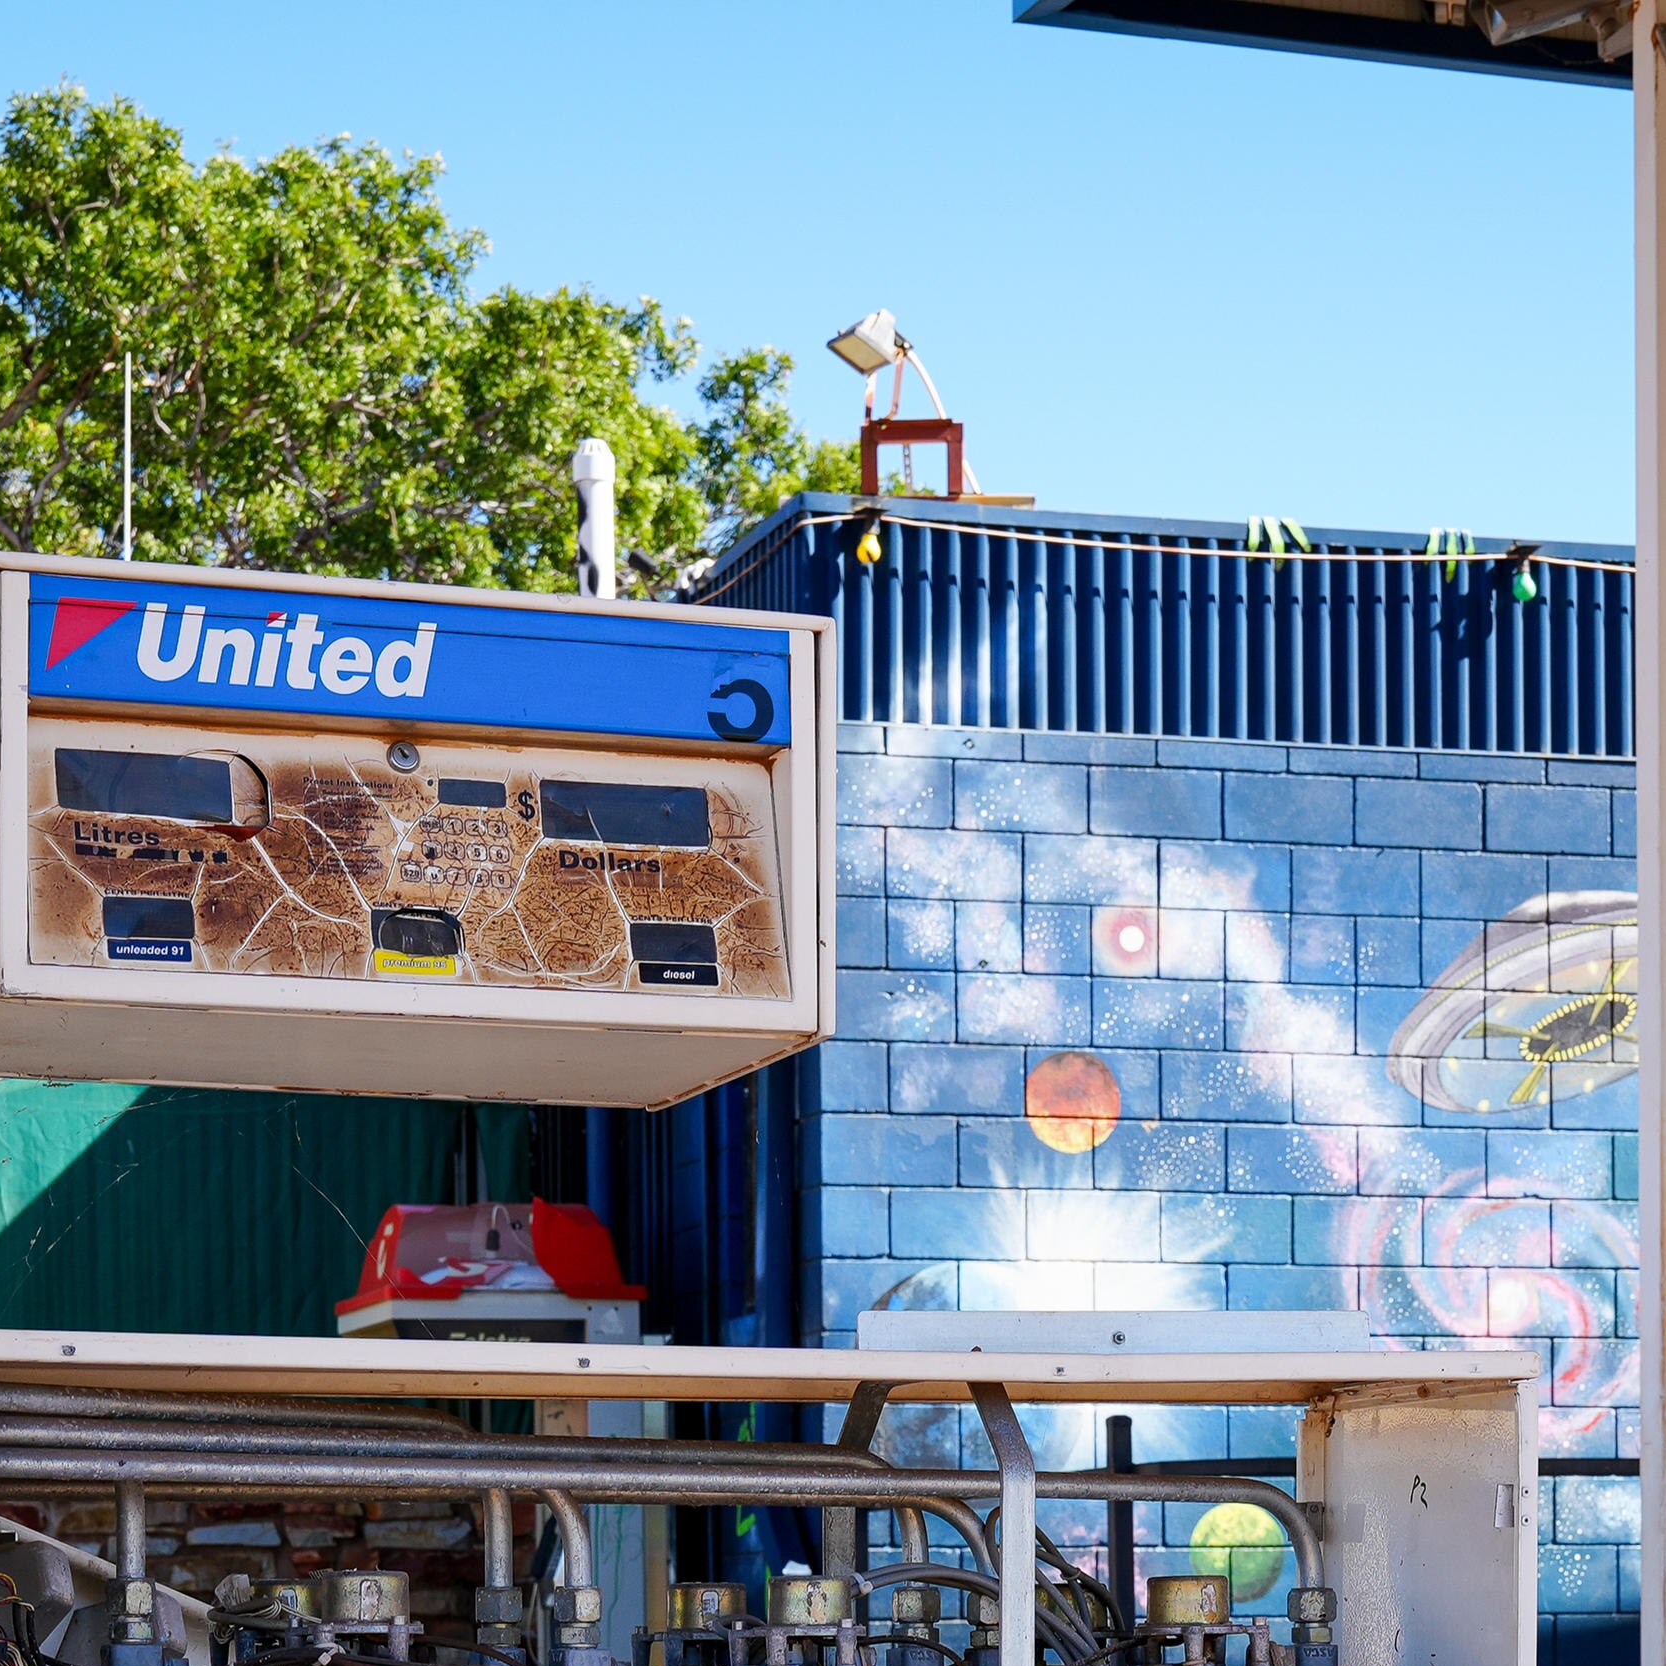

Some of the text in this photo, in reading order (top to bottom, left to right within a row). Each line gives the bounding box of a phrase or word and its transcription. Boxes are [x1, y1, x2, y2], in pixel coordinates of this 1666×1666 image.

[136, 602, 438, 698] United
[337, 778, 393, 789] Instructions
[517, 789, 536, 822] $
[74, 821, 160, 846] Litres
[559, 850, 661, 873] Dollars
[631, 914, 713, 925] CENTS PER LITRE
[116, 945, 184, 956] unleaded 91
[383, 959, 431, 968] premium
[663, 969, 696, 980] diesel
[1410, 1474, 1428, 1509] P2
